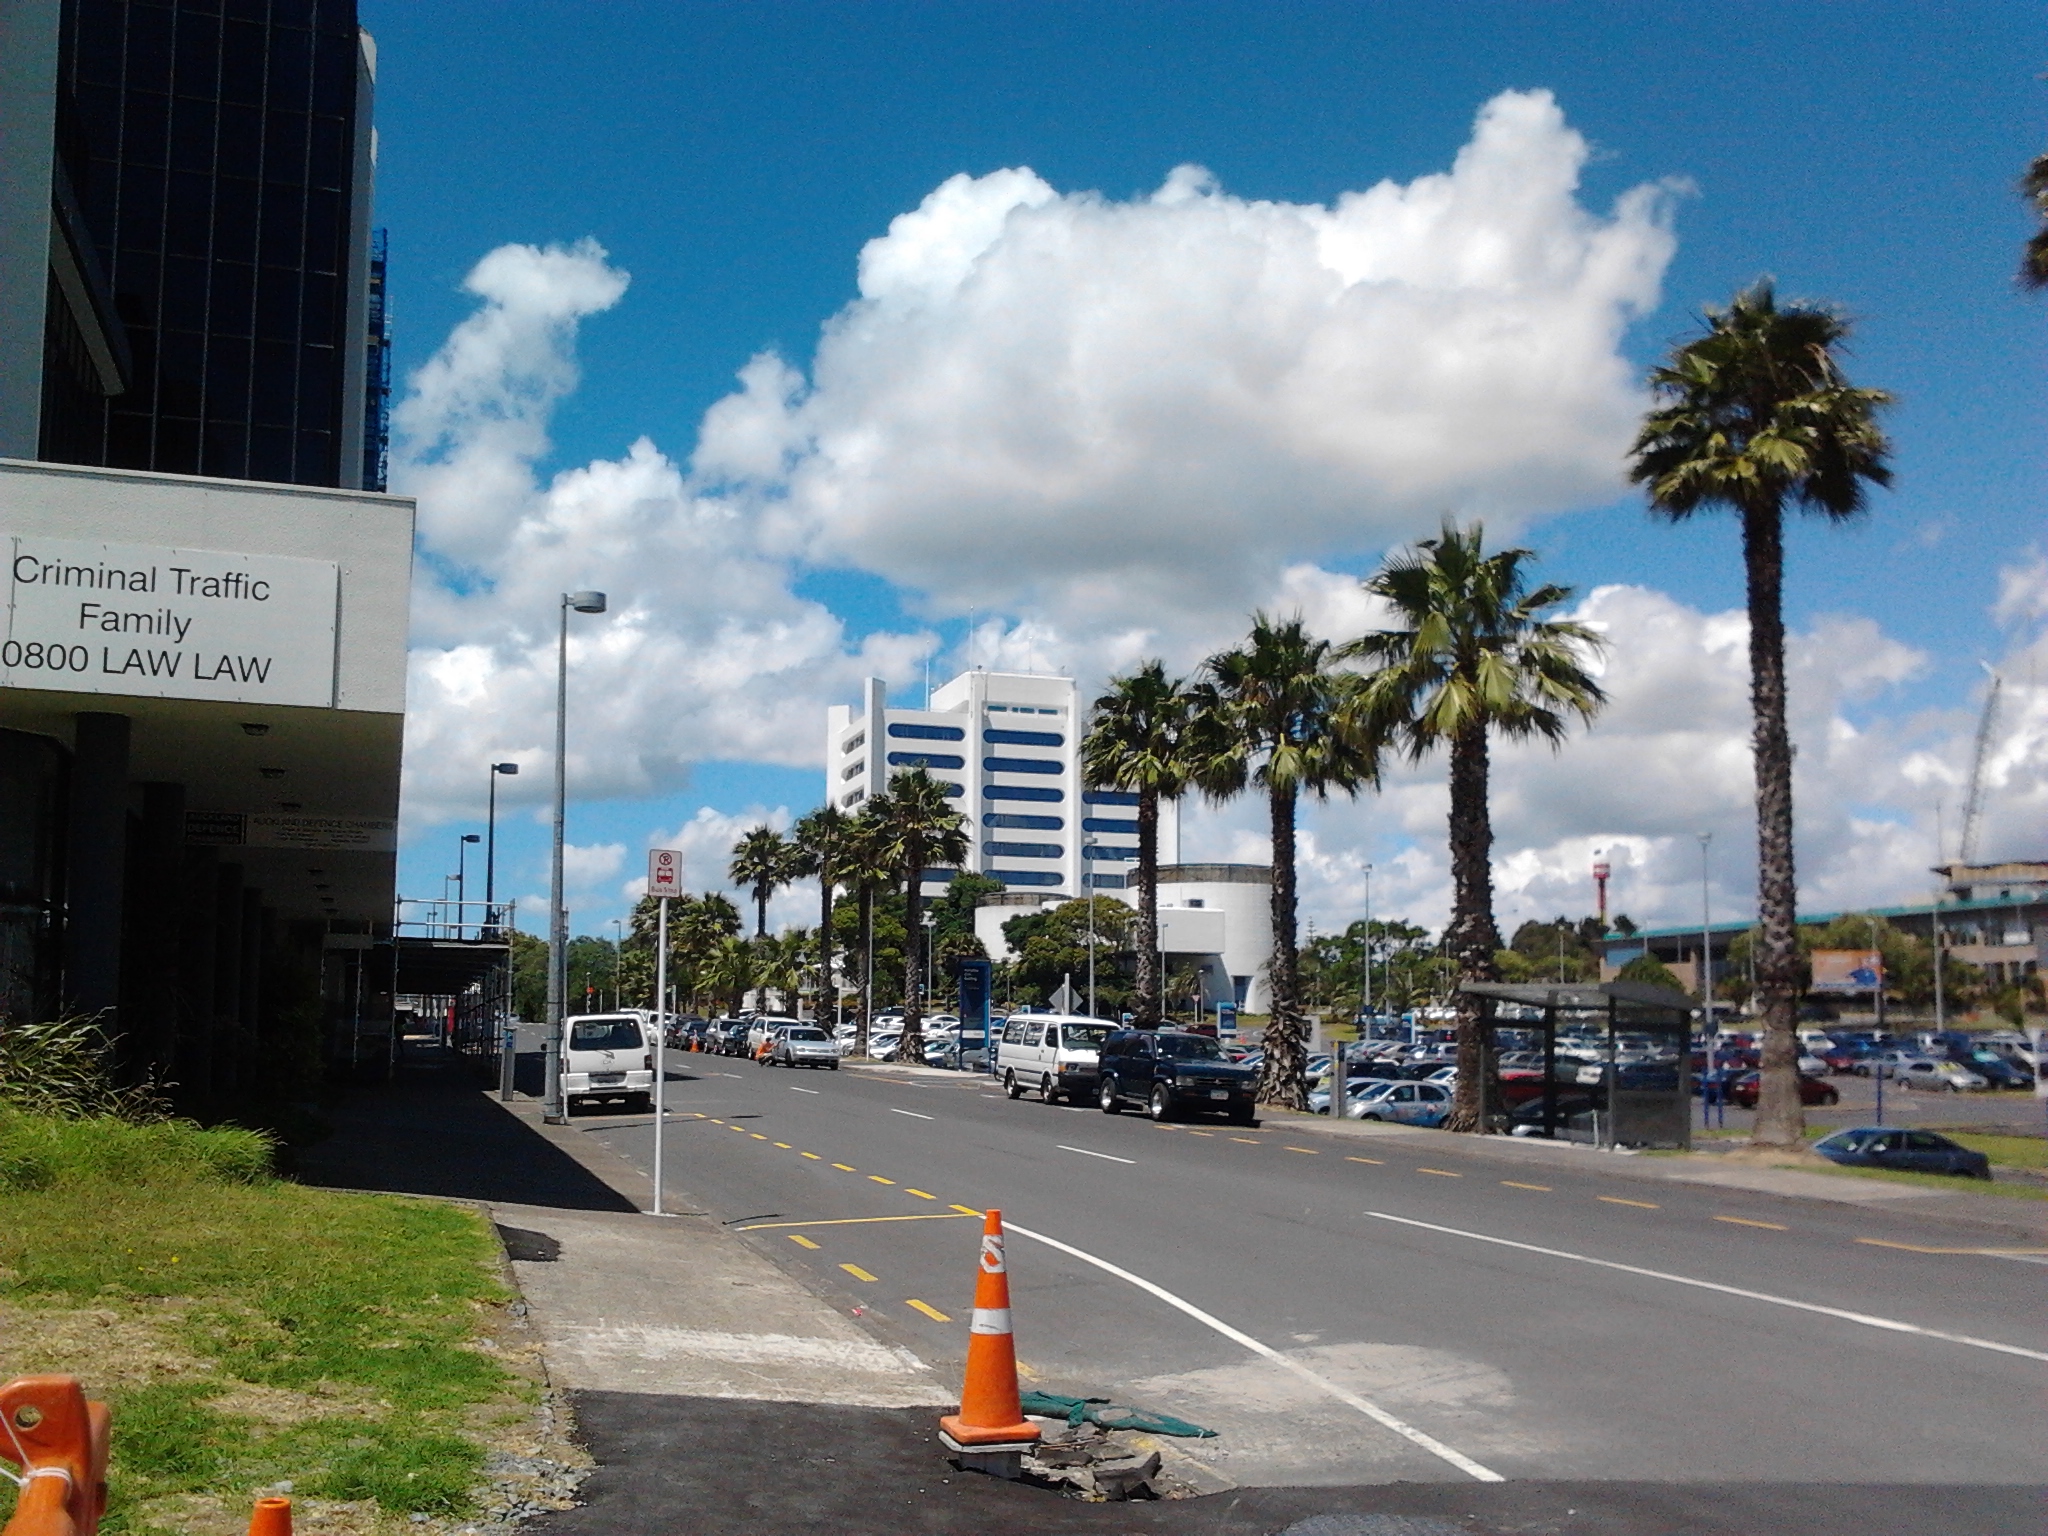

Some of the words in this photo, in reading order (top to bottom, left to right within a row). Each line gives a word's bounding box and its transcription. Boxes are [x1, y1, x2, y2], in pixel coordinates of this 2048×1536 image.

[13, 555, 156, 593] Criminal
[170, 567, 271, 601] Traffic
[79, 602, 192, 643] Family
[2, 640, 89, 672] 0800
[102, 646, 182, 678] LAW
[194, 652, 272, 684] LAW
[187, 823, 240, 834] DEFENCE
